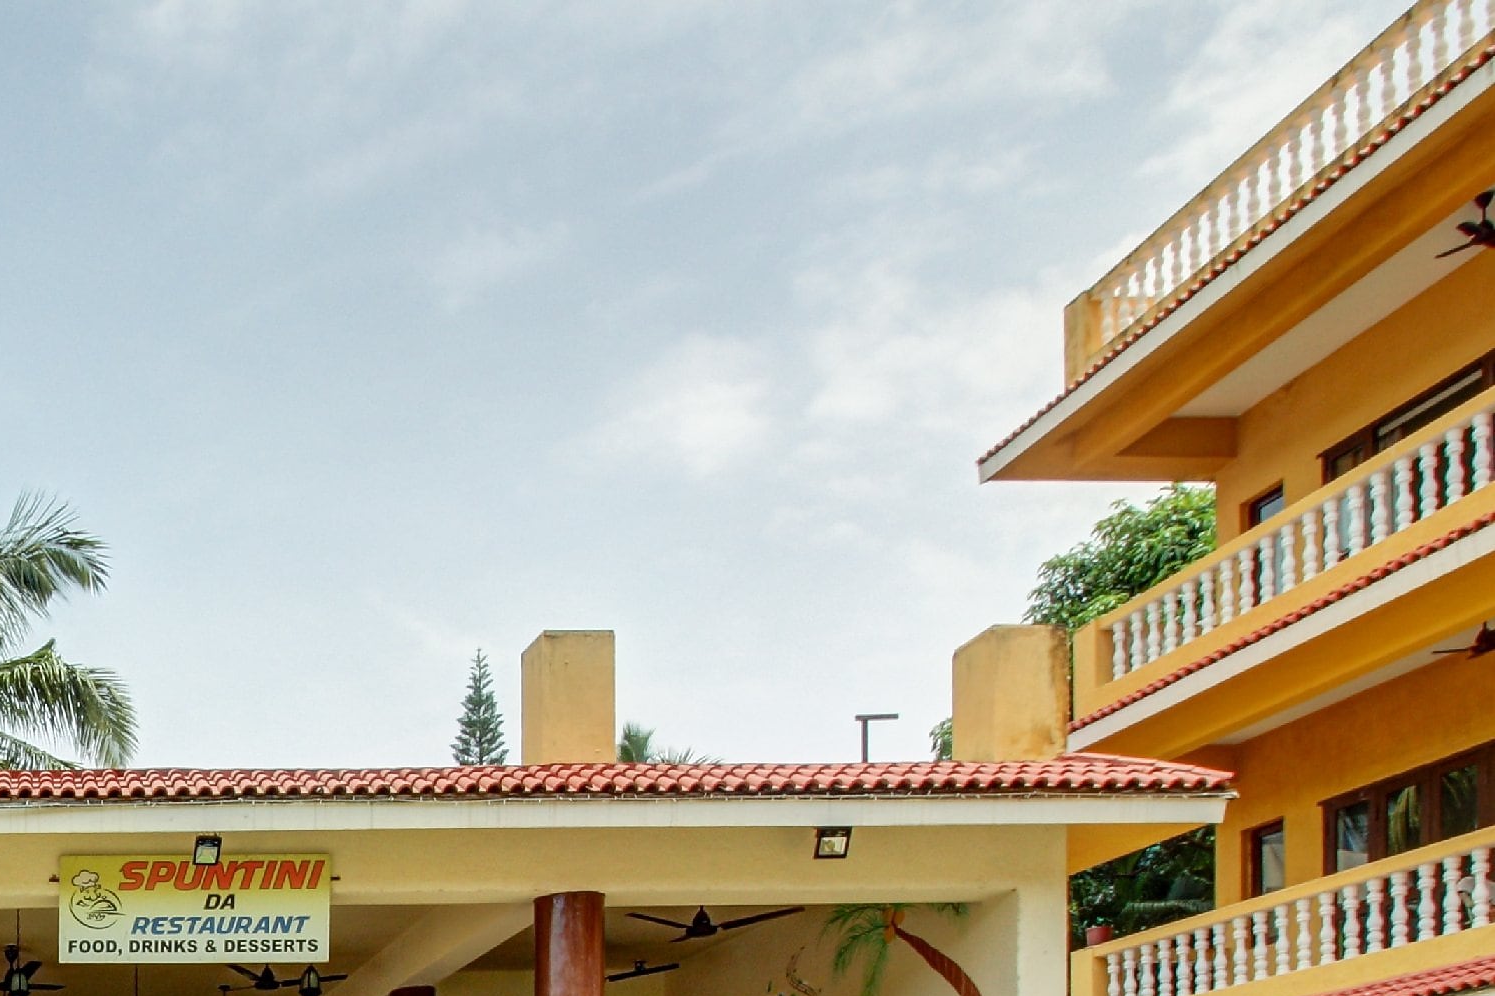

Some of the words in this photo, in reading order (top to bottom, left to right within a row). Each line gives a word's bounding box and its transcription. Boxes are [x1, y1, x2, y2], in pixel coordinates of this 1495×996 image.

[118, 860, 325, 890] SPUNTINI
[204, 894, 235, 910] DA
[131, 916, 310, 935] RESTAURANT
[68, 940, 123, 956] FOOD,
[129, 940, 198, 952] DRINKS
[205, 940, 217, 953] &
[224, 939, 319, 952] DESSERTS
